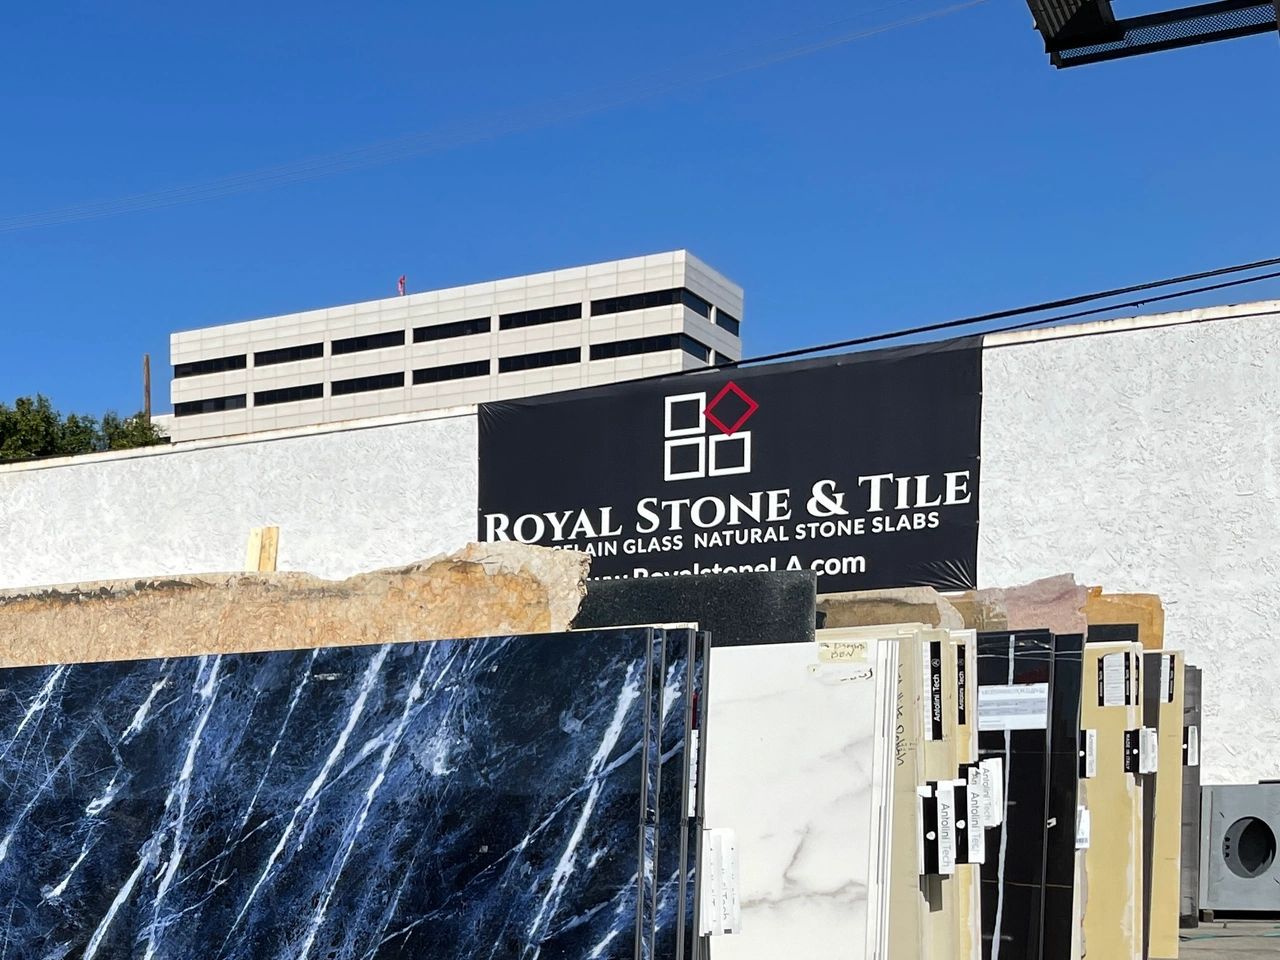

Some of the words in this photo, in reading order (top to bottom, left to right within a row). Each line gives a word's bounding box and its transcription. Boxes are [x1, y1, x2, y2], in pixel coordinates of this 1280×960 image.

[484, 506, 622, 544] ROYAL
[636, 488, 792, 533] STONE
[806, 479, 849, 517] &
[857, 470, 971, 513] TILE
[623, 534, 683, 555] GLASS
[694, 525, 789, 549] NATURAL
[795, 518, 865, 540] STONE
[871, 511, 940, 534] SLABS
